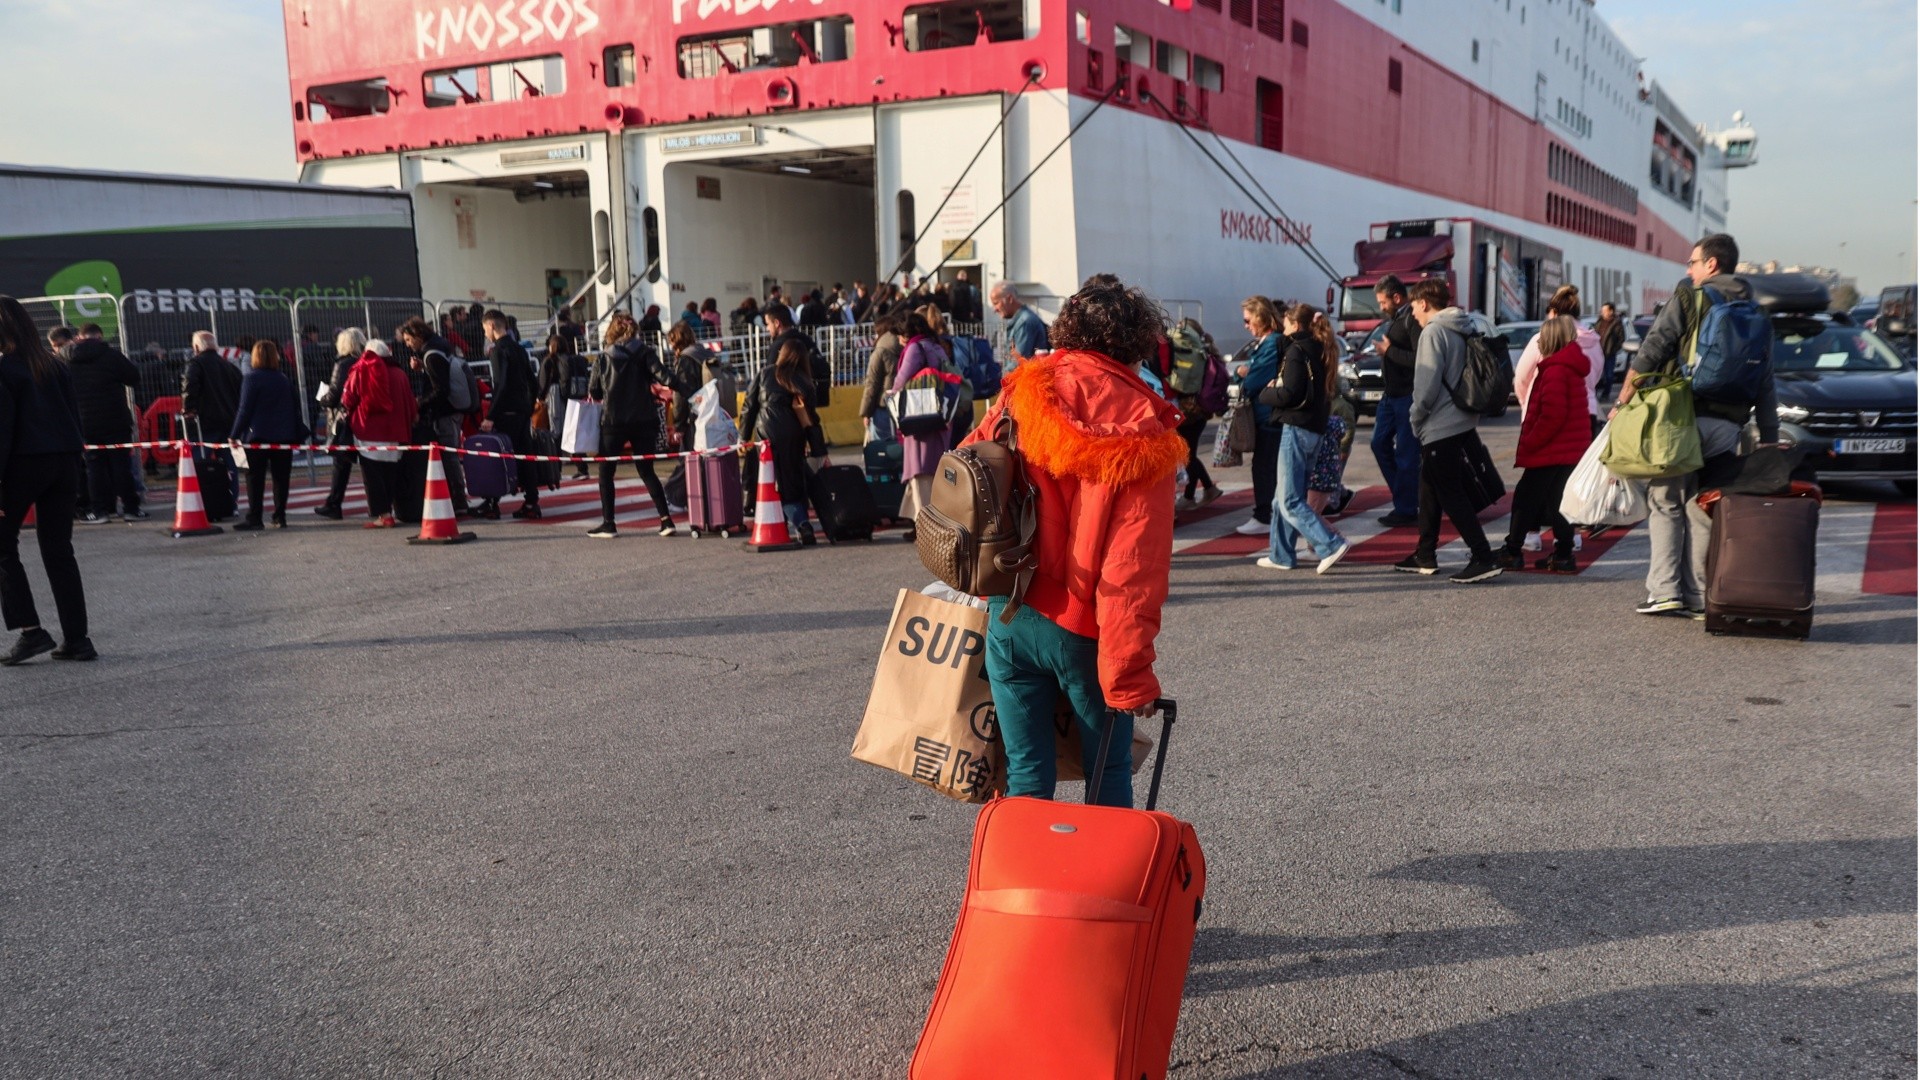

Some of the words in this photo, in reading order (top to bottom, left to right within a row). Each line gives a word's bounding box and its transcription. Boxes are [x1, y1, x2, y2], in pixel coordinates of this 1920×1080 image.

[415, 0, 599, 60] KNOSSOS
[665, 136, 691, 150] MILOS
[696, 132, 741, 147] HERAKLION
[1582, 264, 1632, 318] LINES
[898, 615, 989, 682] SUP
